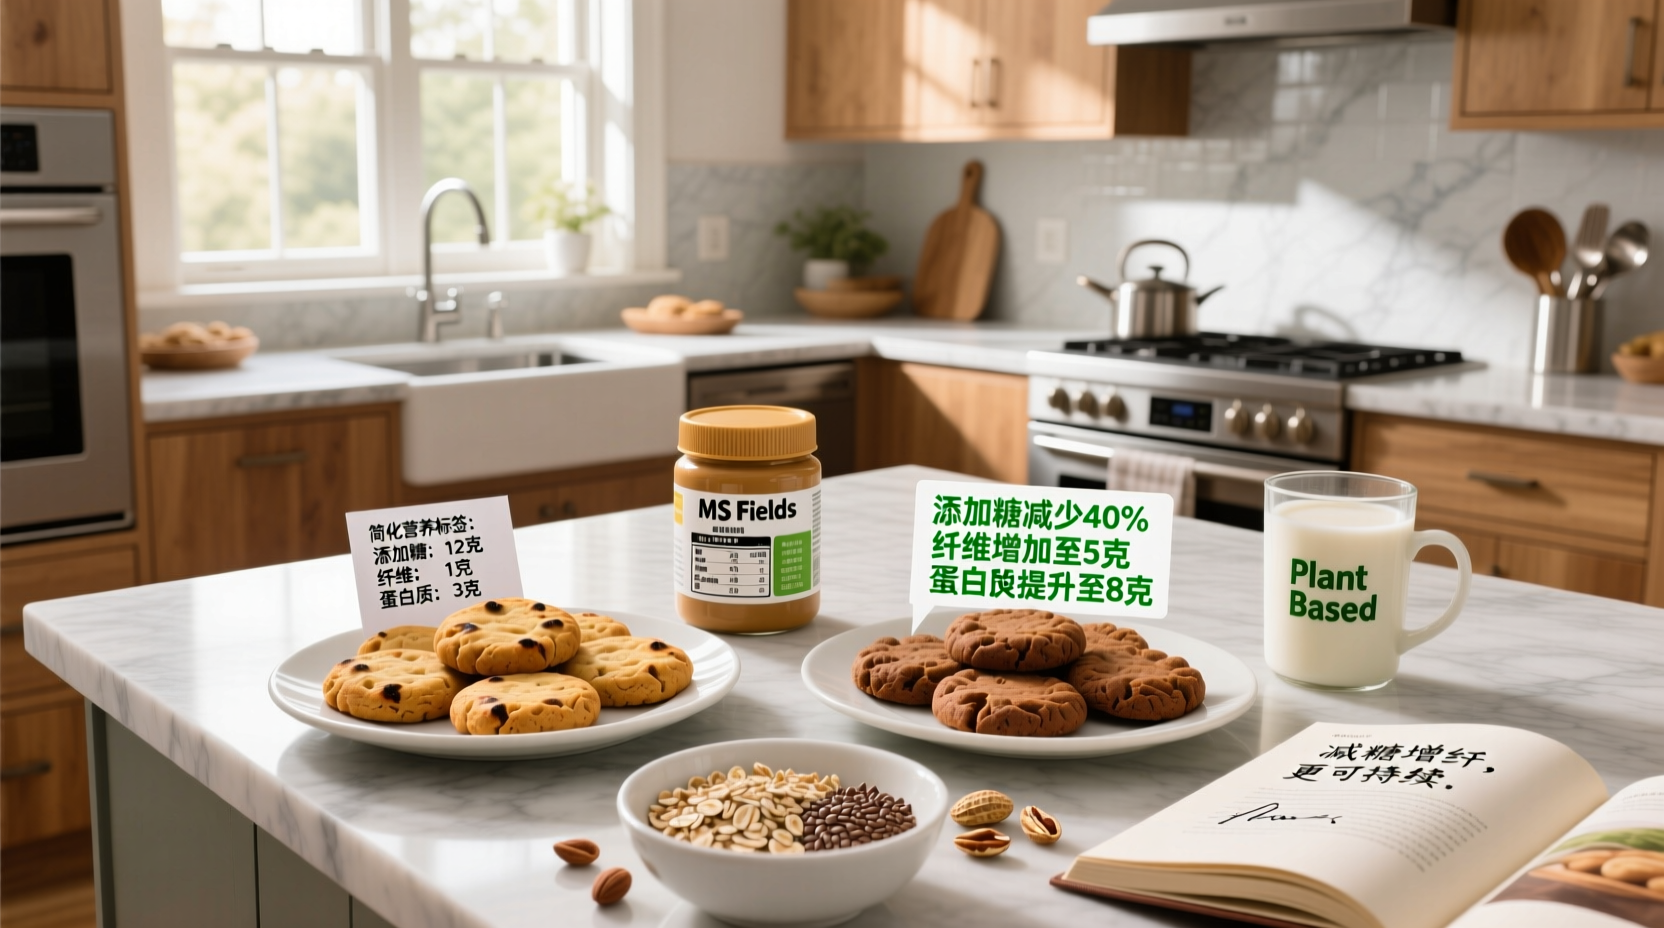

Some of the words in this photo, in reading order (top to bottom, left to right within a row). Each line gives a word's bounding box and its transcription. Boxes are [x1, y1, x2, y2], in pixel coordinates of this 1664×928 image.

[699, 498, 732, 521] MS
[736, 497, 797, 521] Fields
[932, 494, 1149, 532] 添加糖减少40%
[931, 530, 1131, 569] 纤维增加至5克
[1290, 558, 1368, 591] Plant
[1289, 589, 1378, 623] Based
